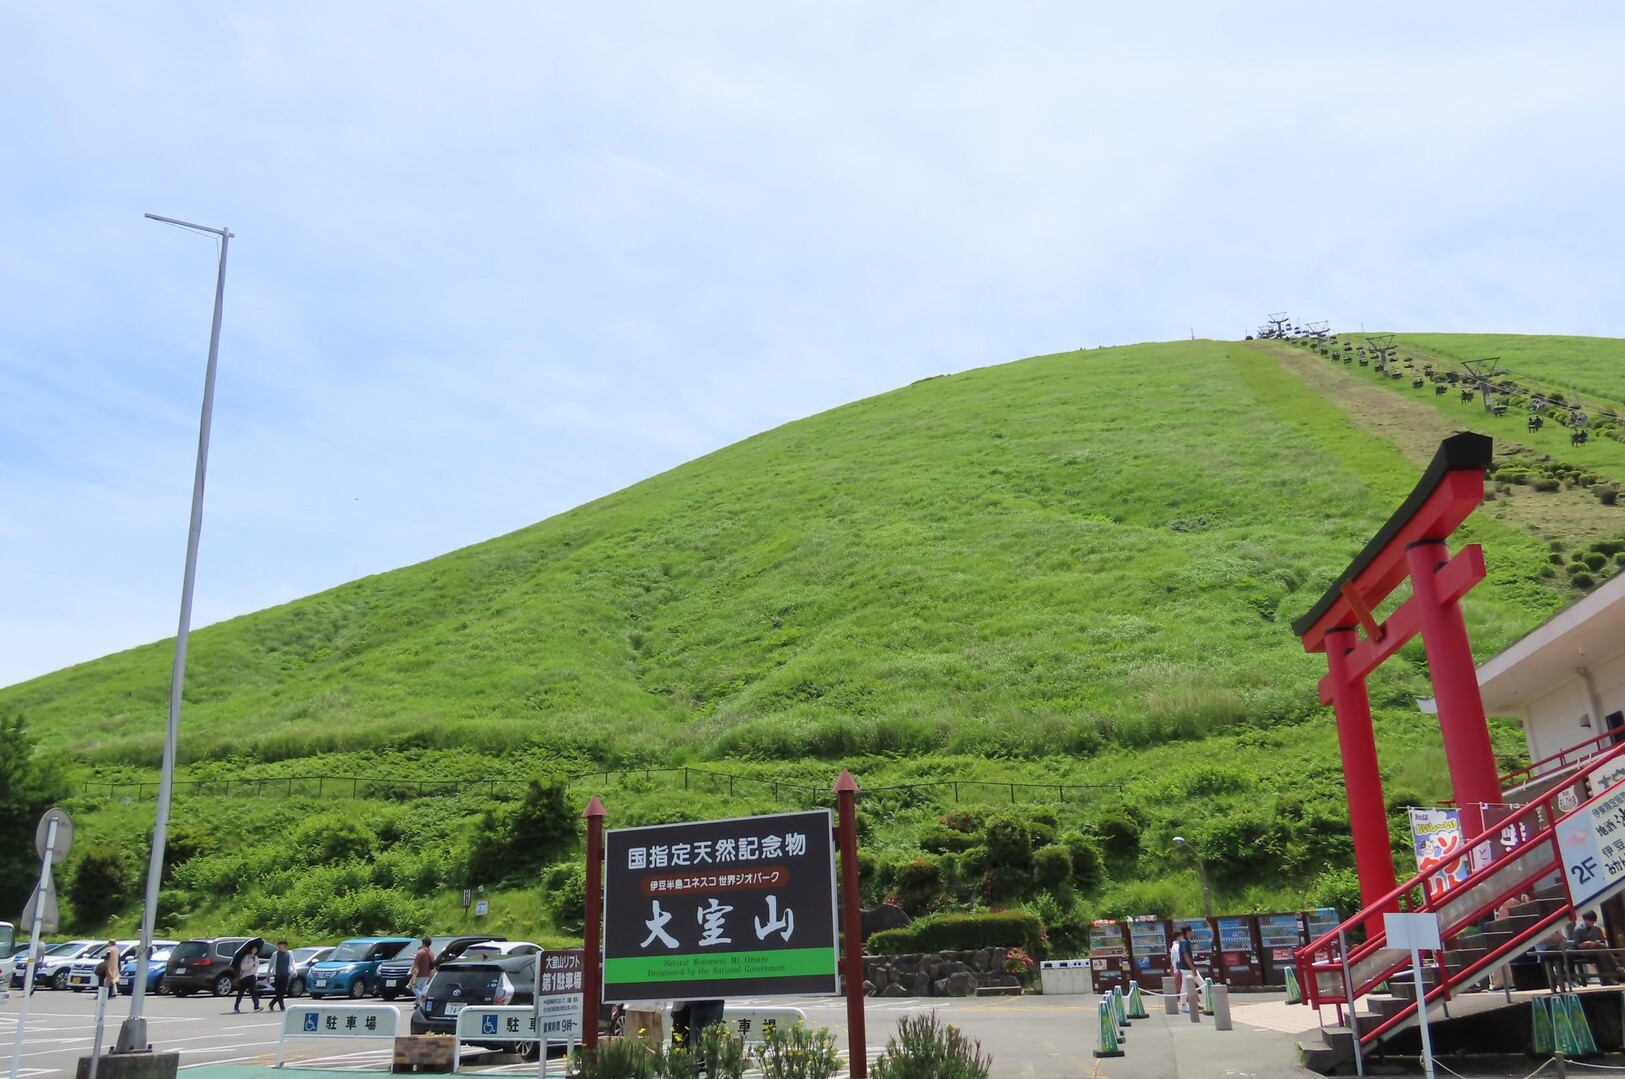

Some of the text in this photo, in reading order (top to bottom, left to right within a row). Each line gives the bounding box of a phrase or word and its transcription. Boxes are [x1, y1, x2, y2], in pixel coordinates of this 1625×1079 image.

[628, 832, 806, 870] 国指定天然記念物
[1571, 856, 1598, 885] 2F
[650, 877, 717, 892] 伊豆半島ユネスコ
[640, 895, 795, 949] 大室山
[545, 955, 580, 969] 大室山リフト
[664, 959, 689, 967] Natural
[693, 957, 726, 966] Monument
[648, 964, 786, 977] Designated by the National Government
[542, 971, 582, 991] 第1駐車場
[325, 1014, 377, 1031] 駐車場
[723, 1018, 777, 1034] 車場
